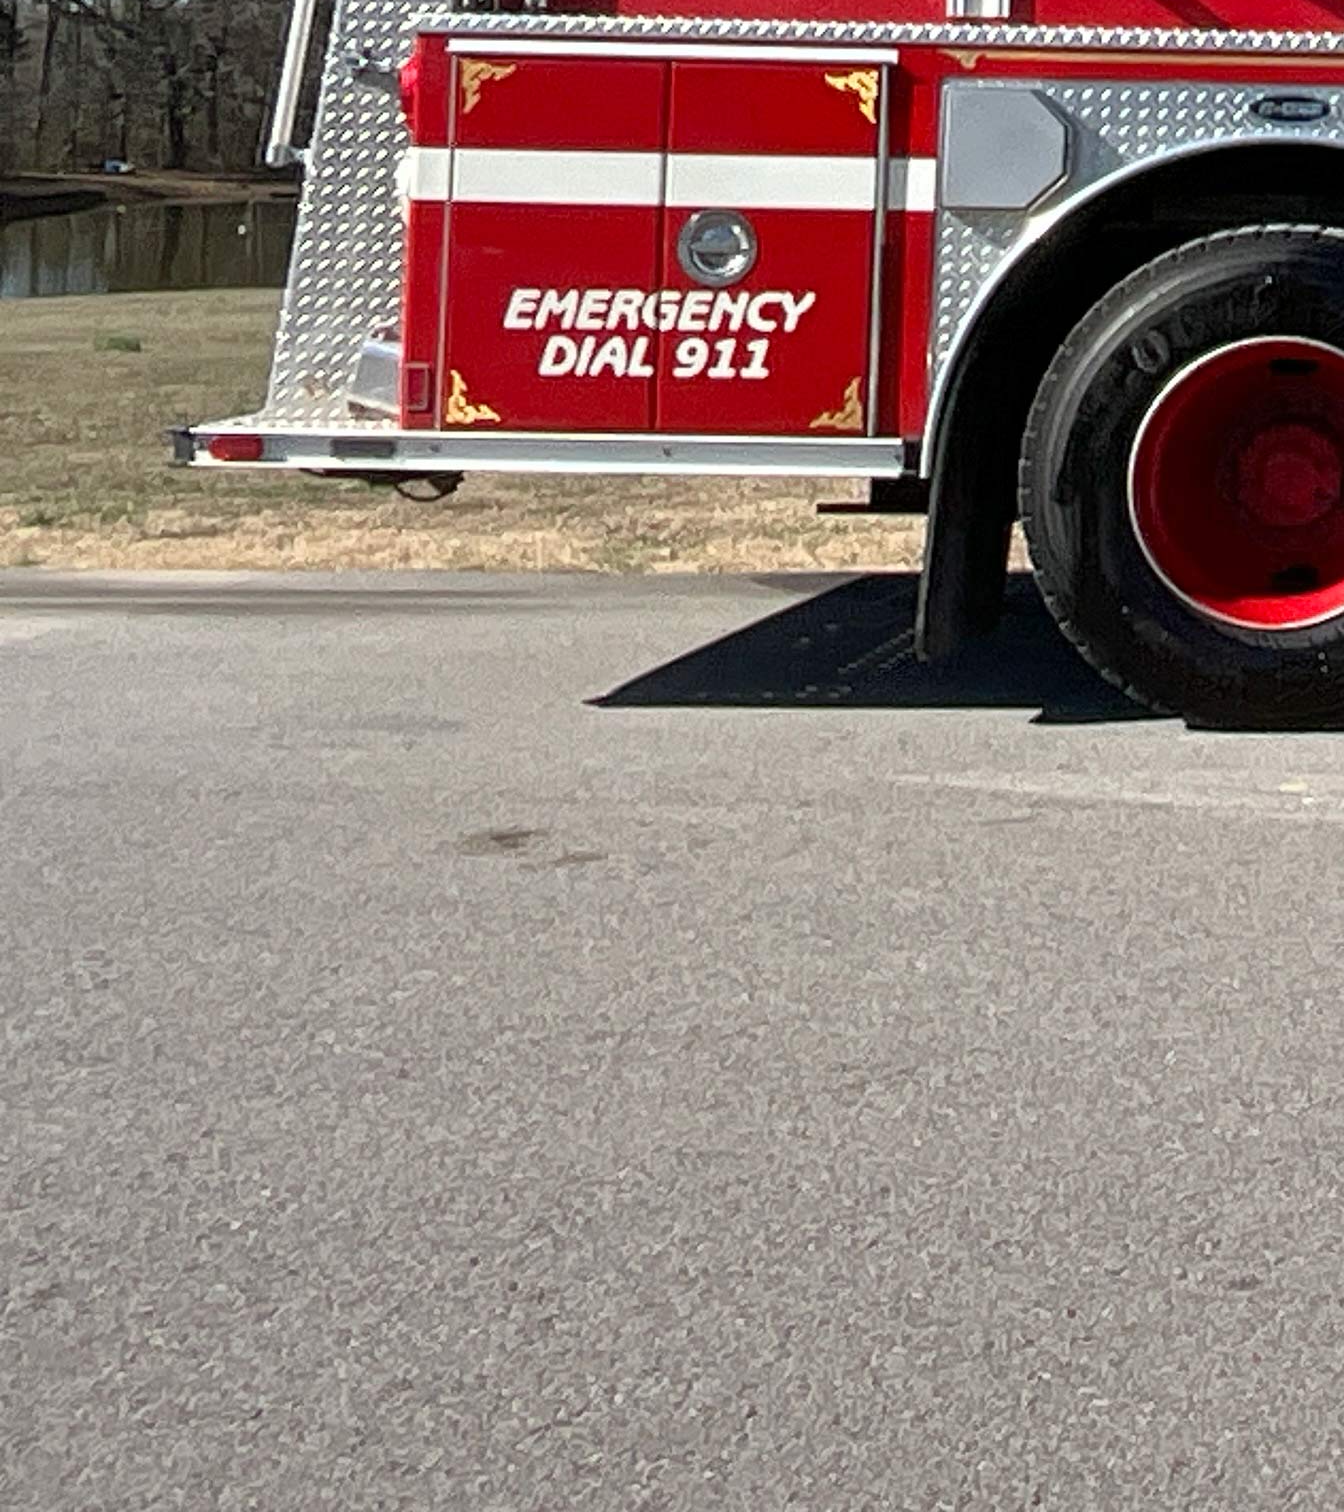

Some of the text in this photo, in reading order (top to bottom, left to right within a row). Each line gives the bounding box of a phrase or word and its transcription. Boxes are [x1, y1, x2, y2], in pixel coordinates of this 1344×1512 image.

[503, 288, 816, 332] EMERGENCY
[538, 335, 770, 379] DIAL 911
